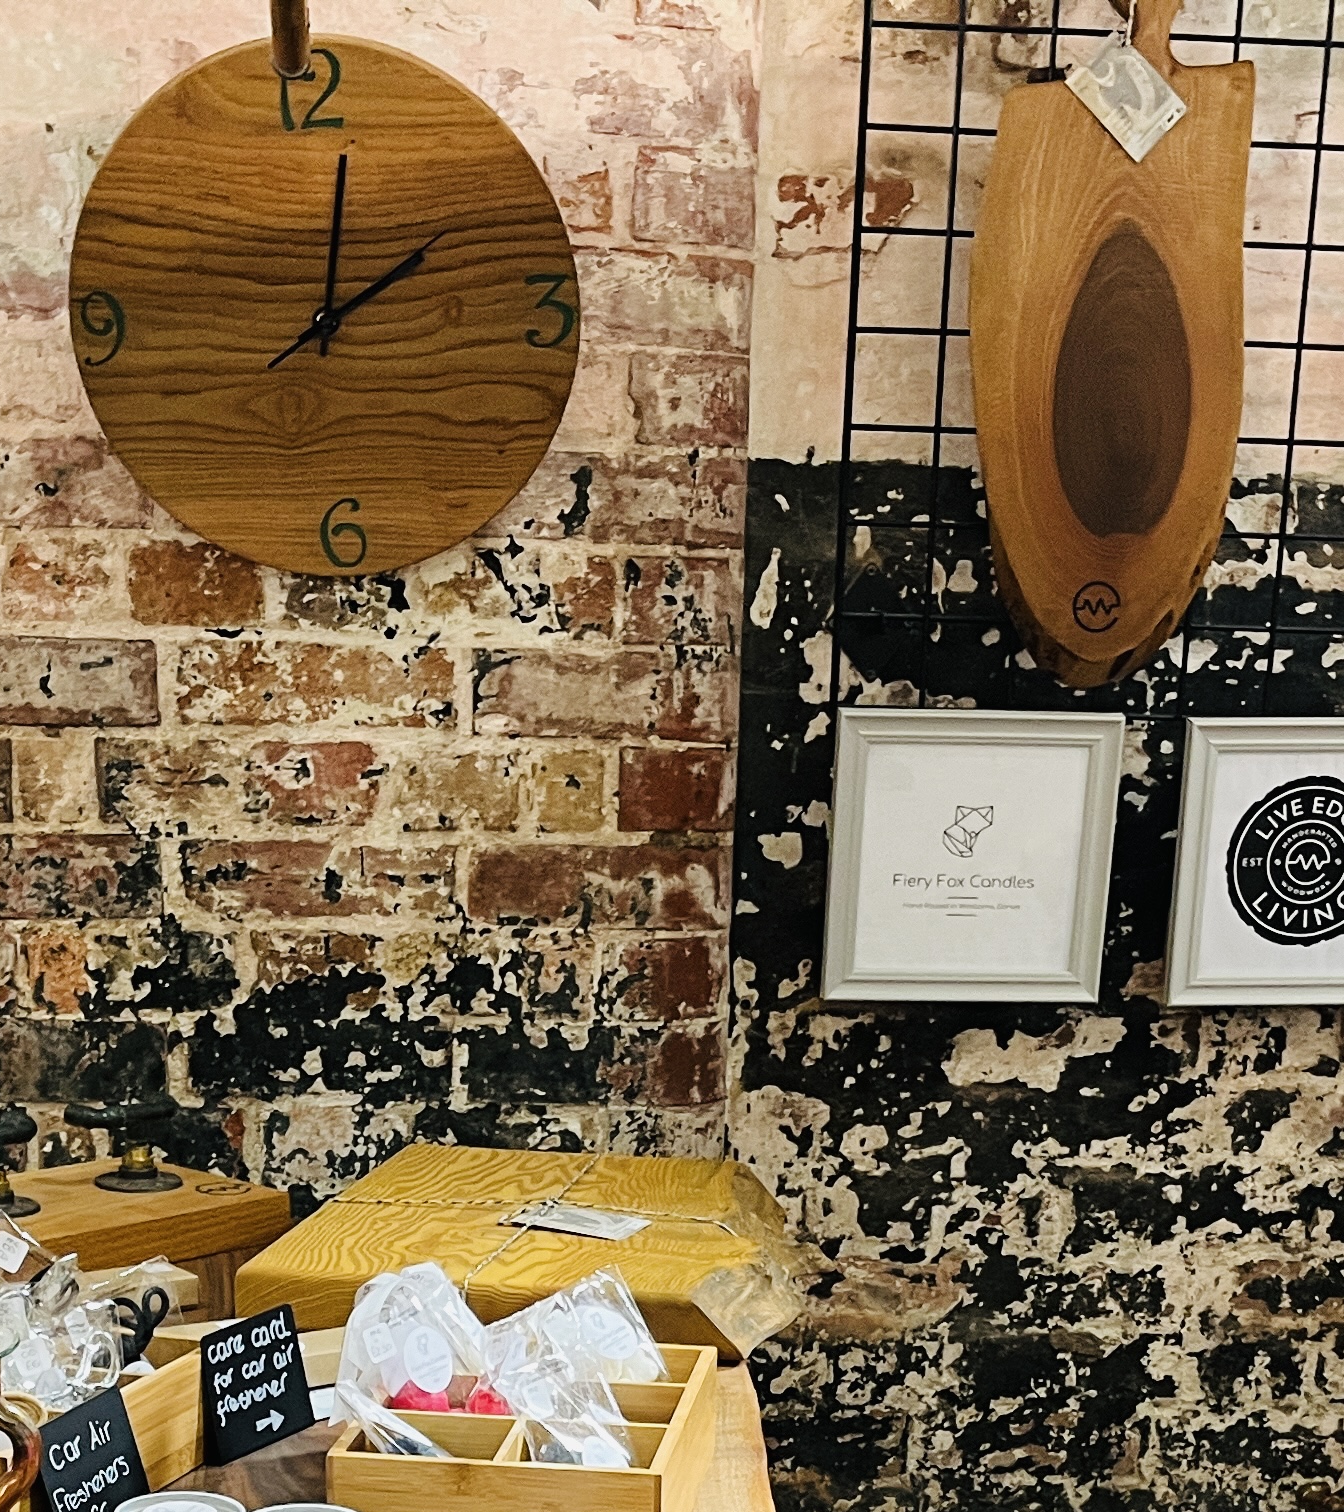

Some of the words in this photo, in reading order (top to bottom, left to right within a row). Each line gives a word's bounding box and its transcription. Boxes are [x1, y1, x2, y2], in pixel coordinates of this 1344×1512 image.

[278, 48, 345, 131] 12
[80, 290, 126, 367] 9
[524, 273, 575, 349] 3
[319, 497, 367, 568] 6
[1255, 797, 1304, 840] LIVE
[892, 873, 933, 891] Fiery
[936, 873, 966, 888] Fox
[969, 874, 1035, 889] Candles
[1241, 857, 1264, 868] EST
[206, 1333, 244, 1365] care
[250, 1311, 292, 1347] card
[213, 1367, 235, 1395] for
[241, 1355, 266, 1381] car
[272, 1343, 296, 1369] air
[216, 1372, 288, 1428] freshener
[49, 1435, 81, 1472] Car
[89, 1419, 112, 1452] Air
